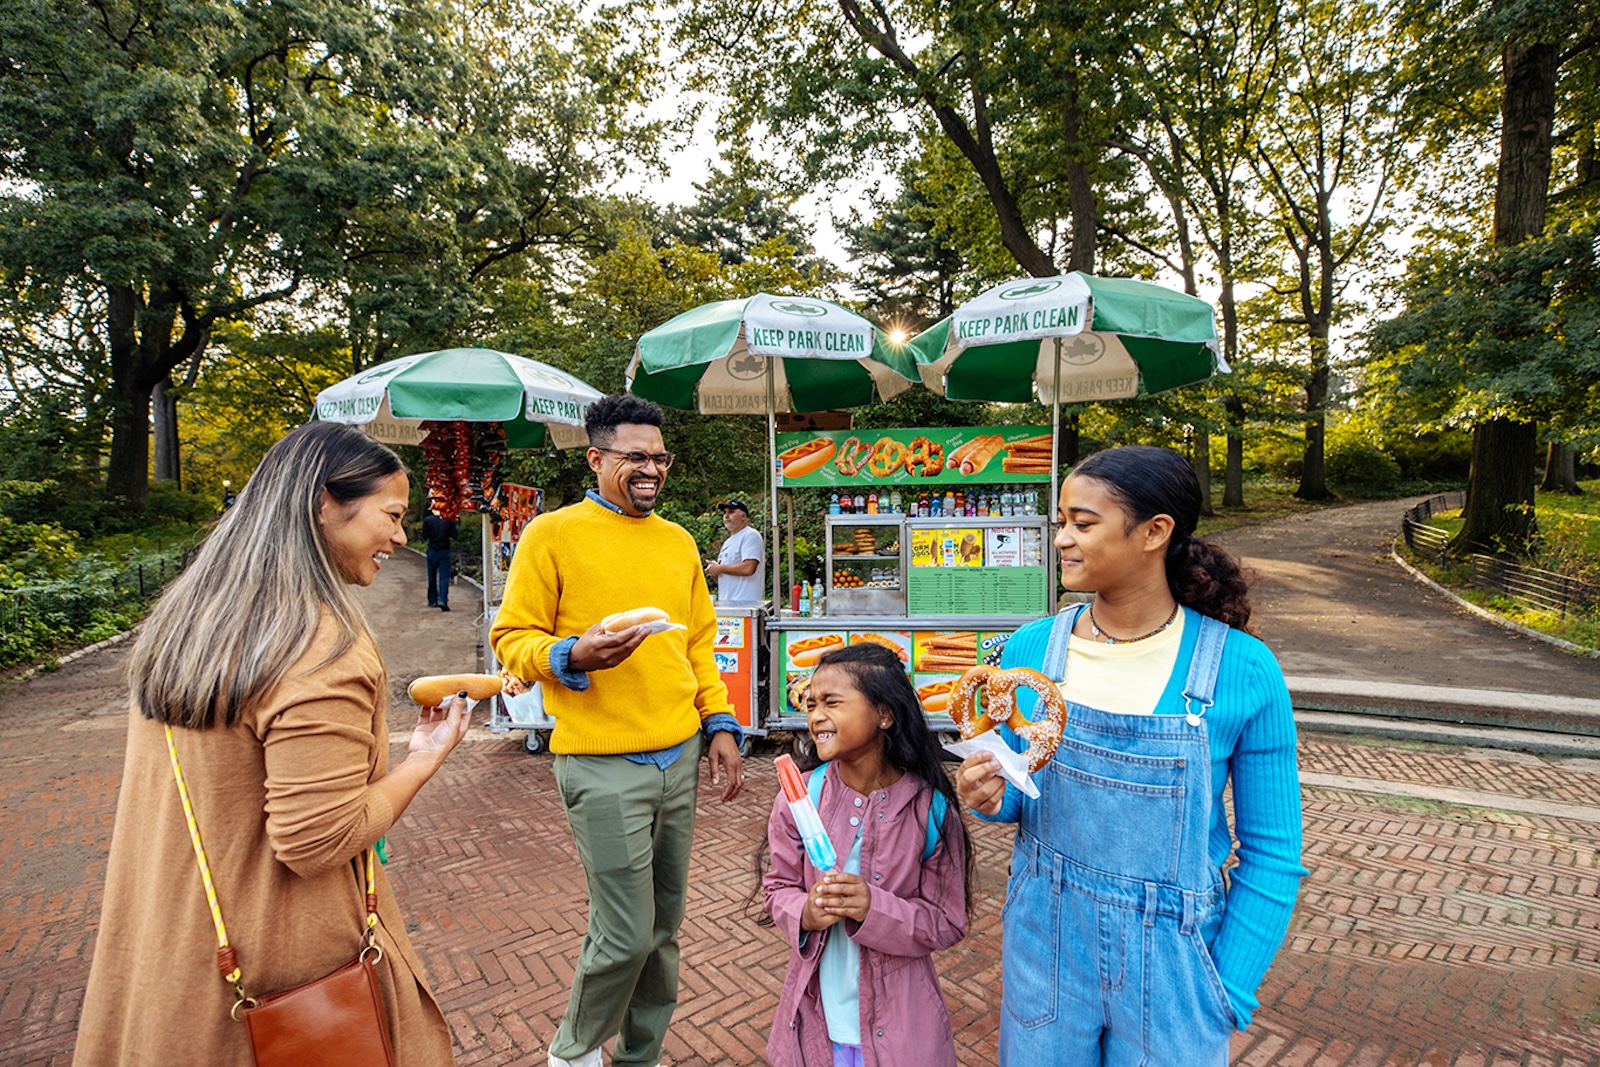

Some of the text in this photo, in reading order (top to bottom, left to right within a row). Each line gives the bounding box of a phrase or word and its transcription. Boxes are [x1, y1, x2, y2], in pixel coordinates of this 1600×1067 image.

[959, 305, 1079, 338] KEEP PARK CLEAN
[753, 327, 865, 352] KEEP PARK CLEAN
[319, 396, 380, 418] KEEP PARK CLEAN
[532, 396, 555, 416] KEEP
[557, 401, 580, 420] PARK
